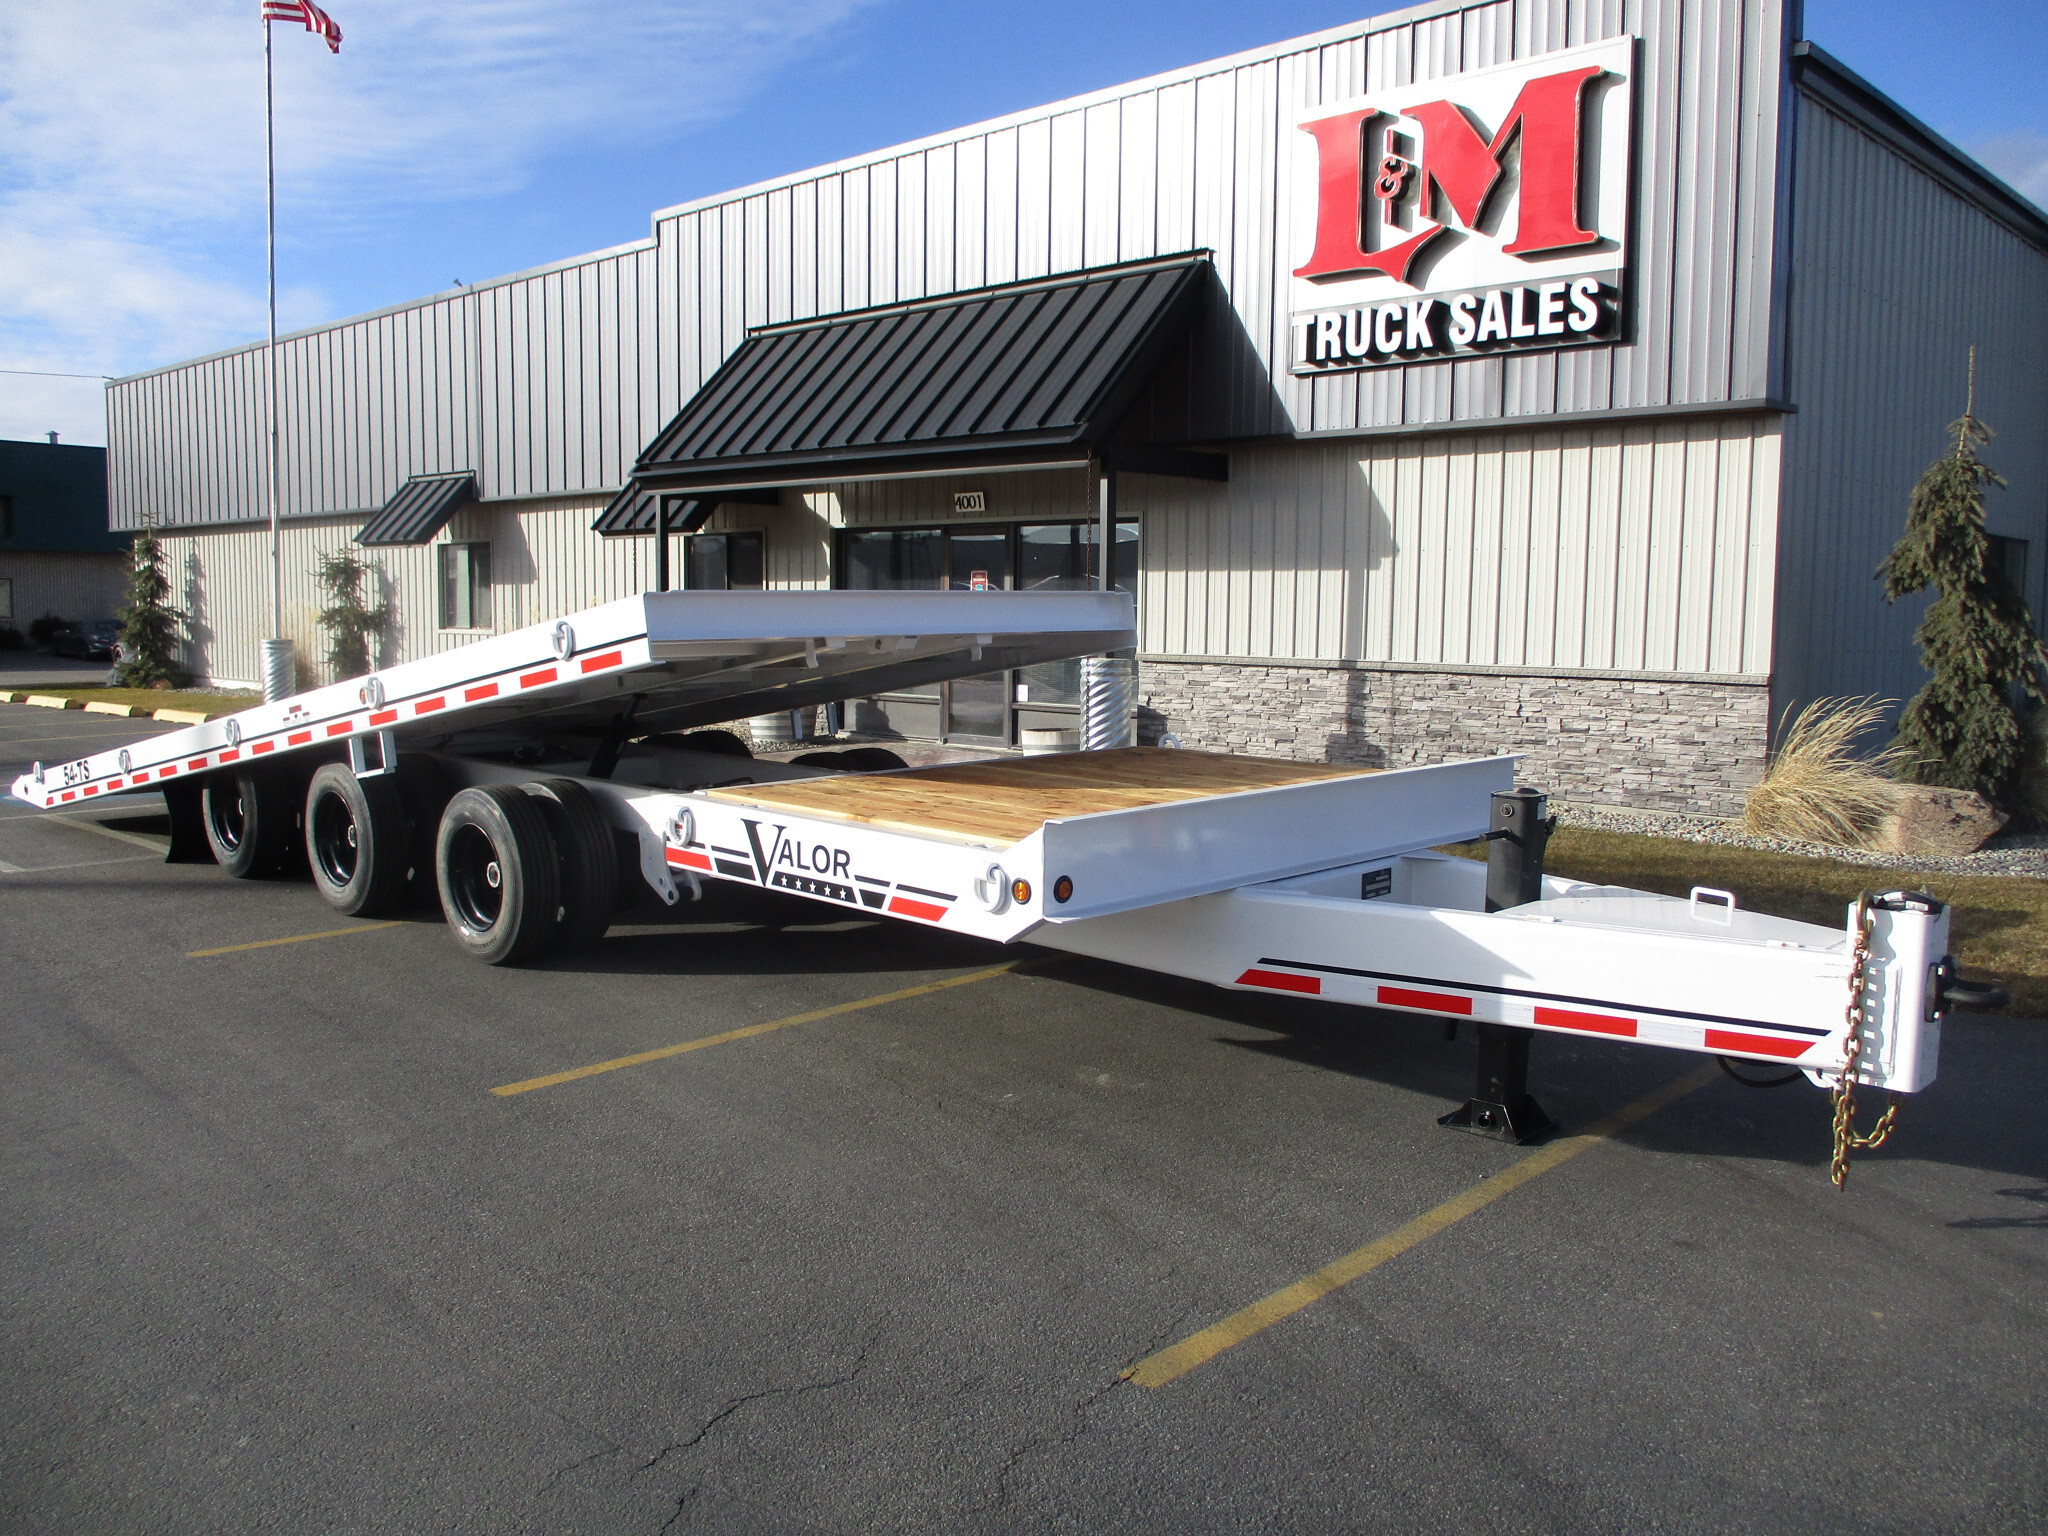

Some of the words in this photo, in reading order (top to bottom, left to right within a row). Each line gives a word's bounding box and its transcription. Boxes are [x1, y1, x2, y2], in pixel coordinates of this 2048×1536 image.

[1292, 299, 1435, 362] TRUCK
[1449, 277, 1600, 347] SALES
[955, 494, 982, 510] 4001
[63, 759, 90, 786] 54-TS
